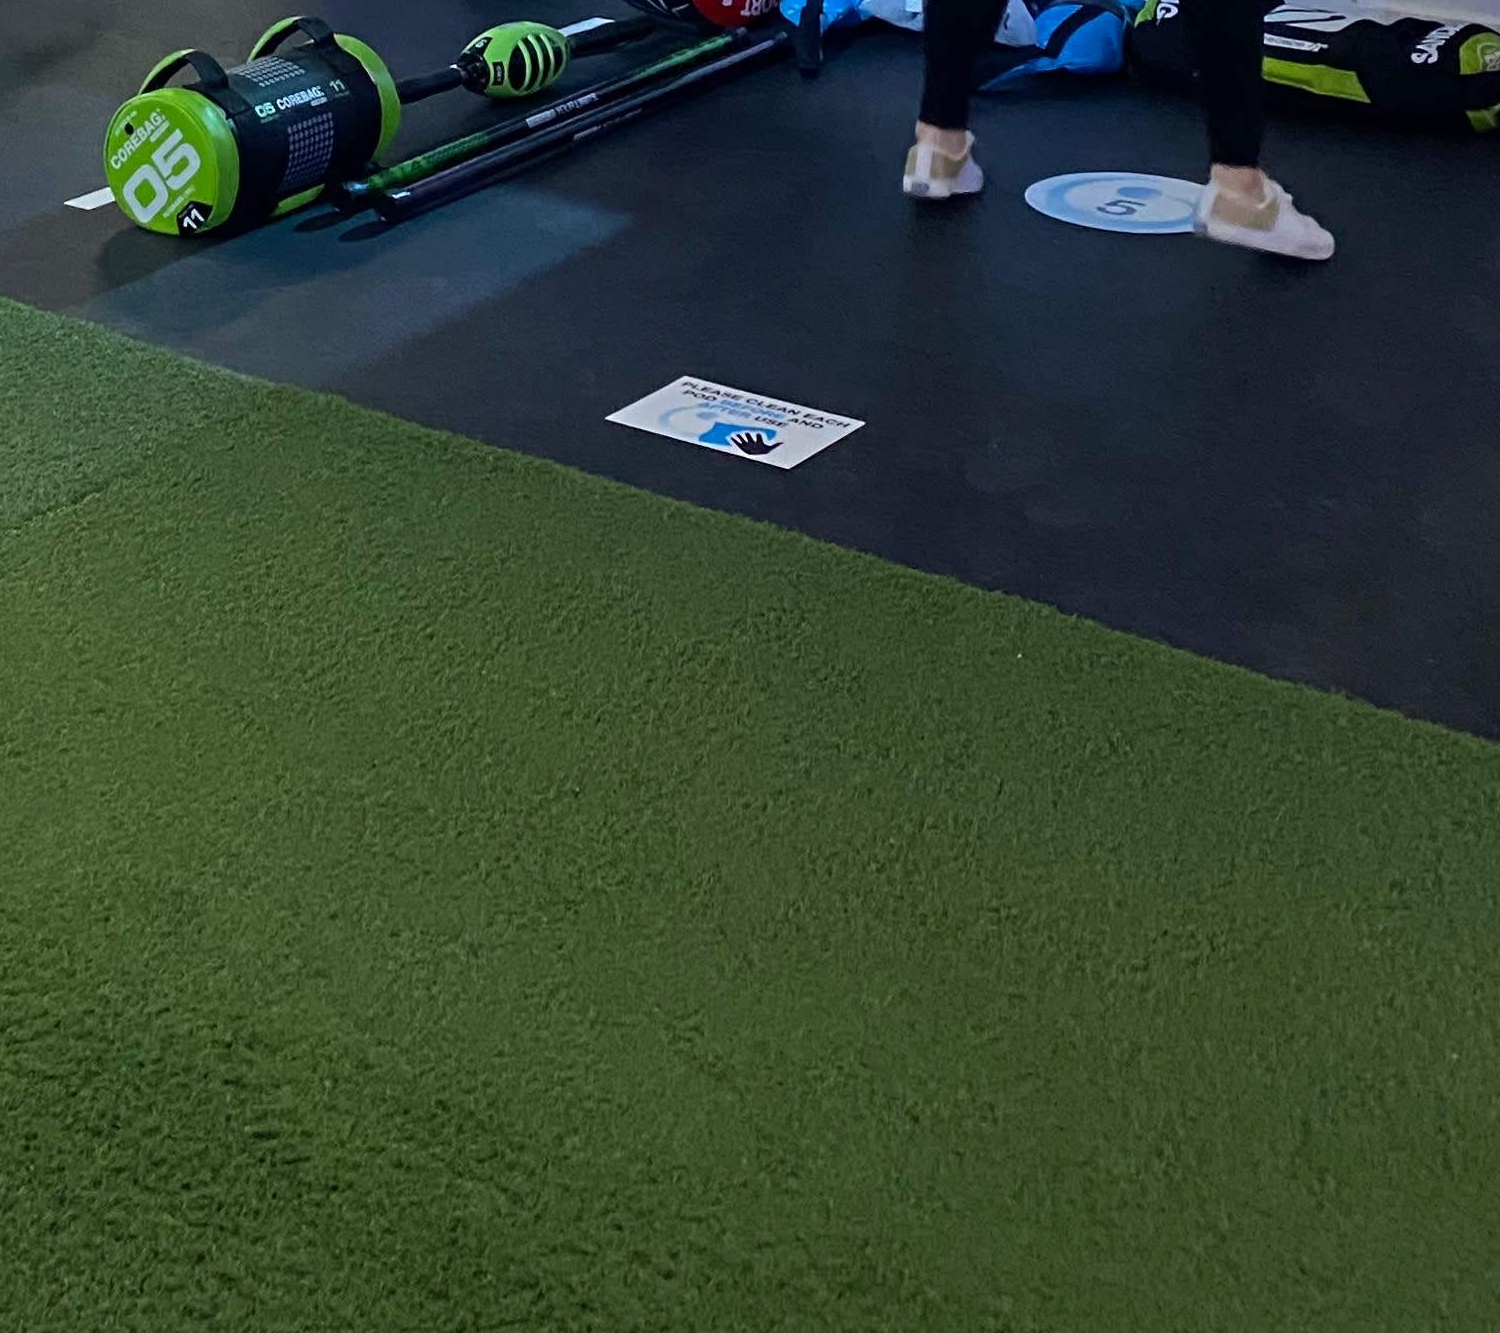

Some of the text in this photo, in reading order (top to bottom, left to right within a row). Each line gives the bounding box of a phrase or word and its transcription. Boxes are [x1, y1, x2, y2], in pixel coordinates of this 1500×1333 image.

[254, 78, 348, 119] 05 COREBAG 11
[122, 128, 201, 224] 05
[182, 207, 205, 231] 11
[1096, 199, 1147, 216] 5
[681, 381, 851, 429] PLEASE CLEAN EACH
[681, 389, 718, 402] POD
[787, 417, 825, 430] AND
[754, 415, 792, 429] USE
